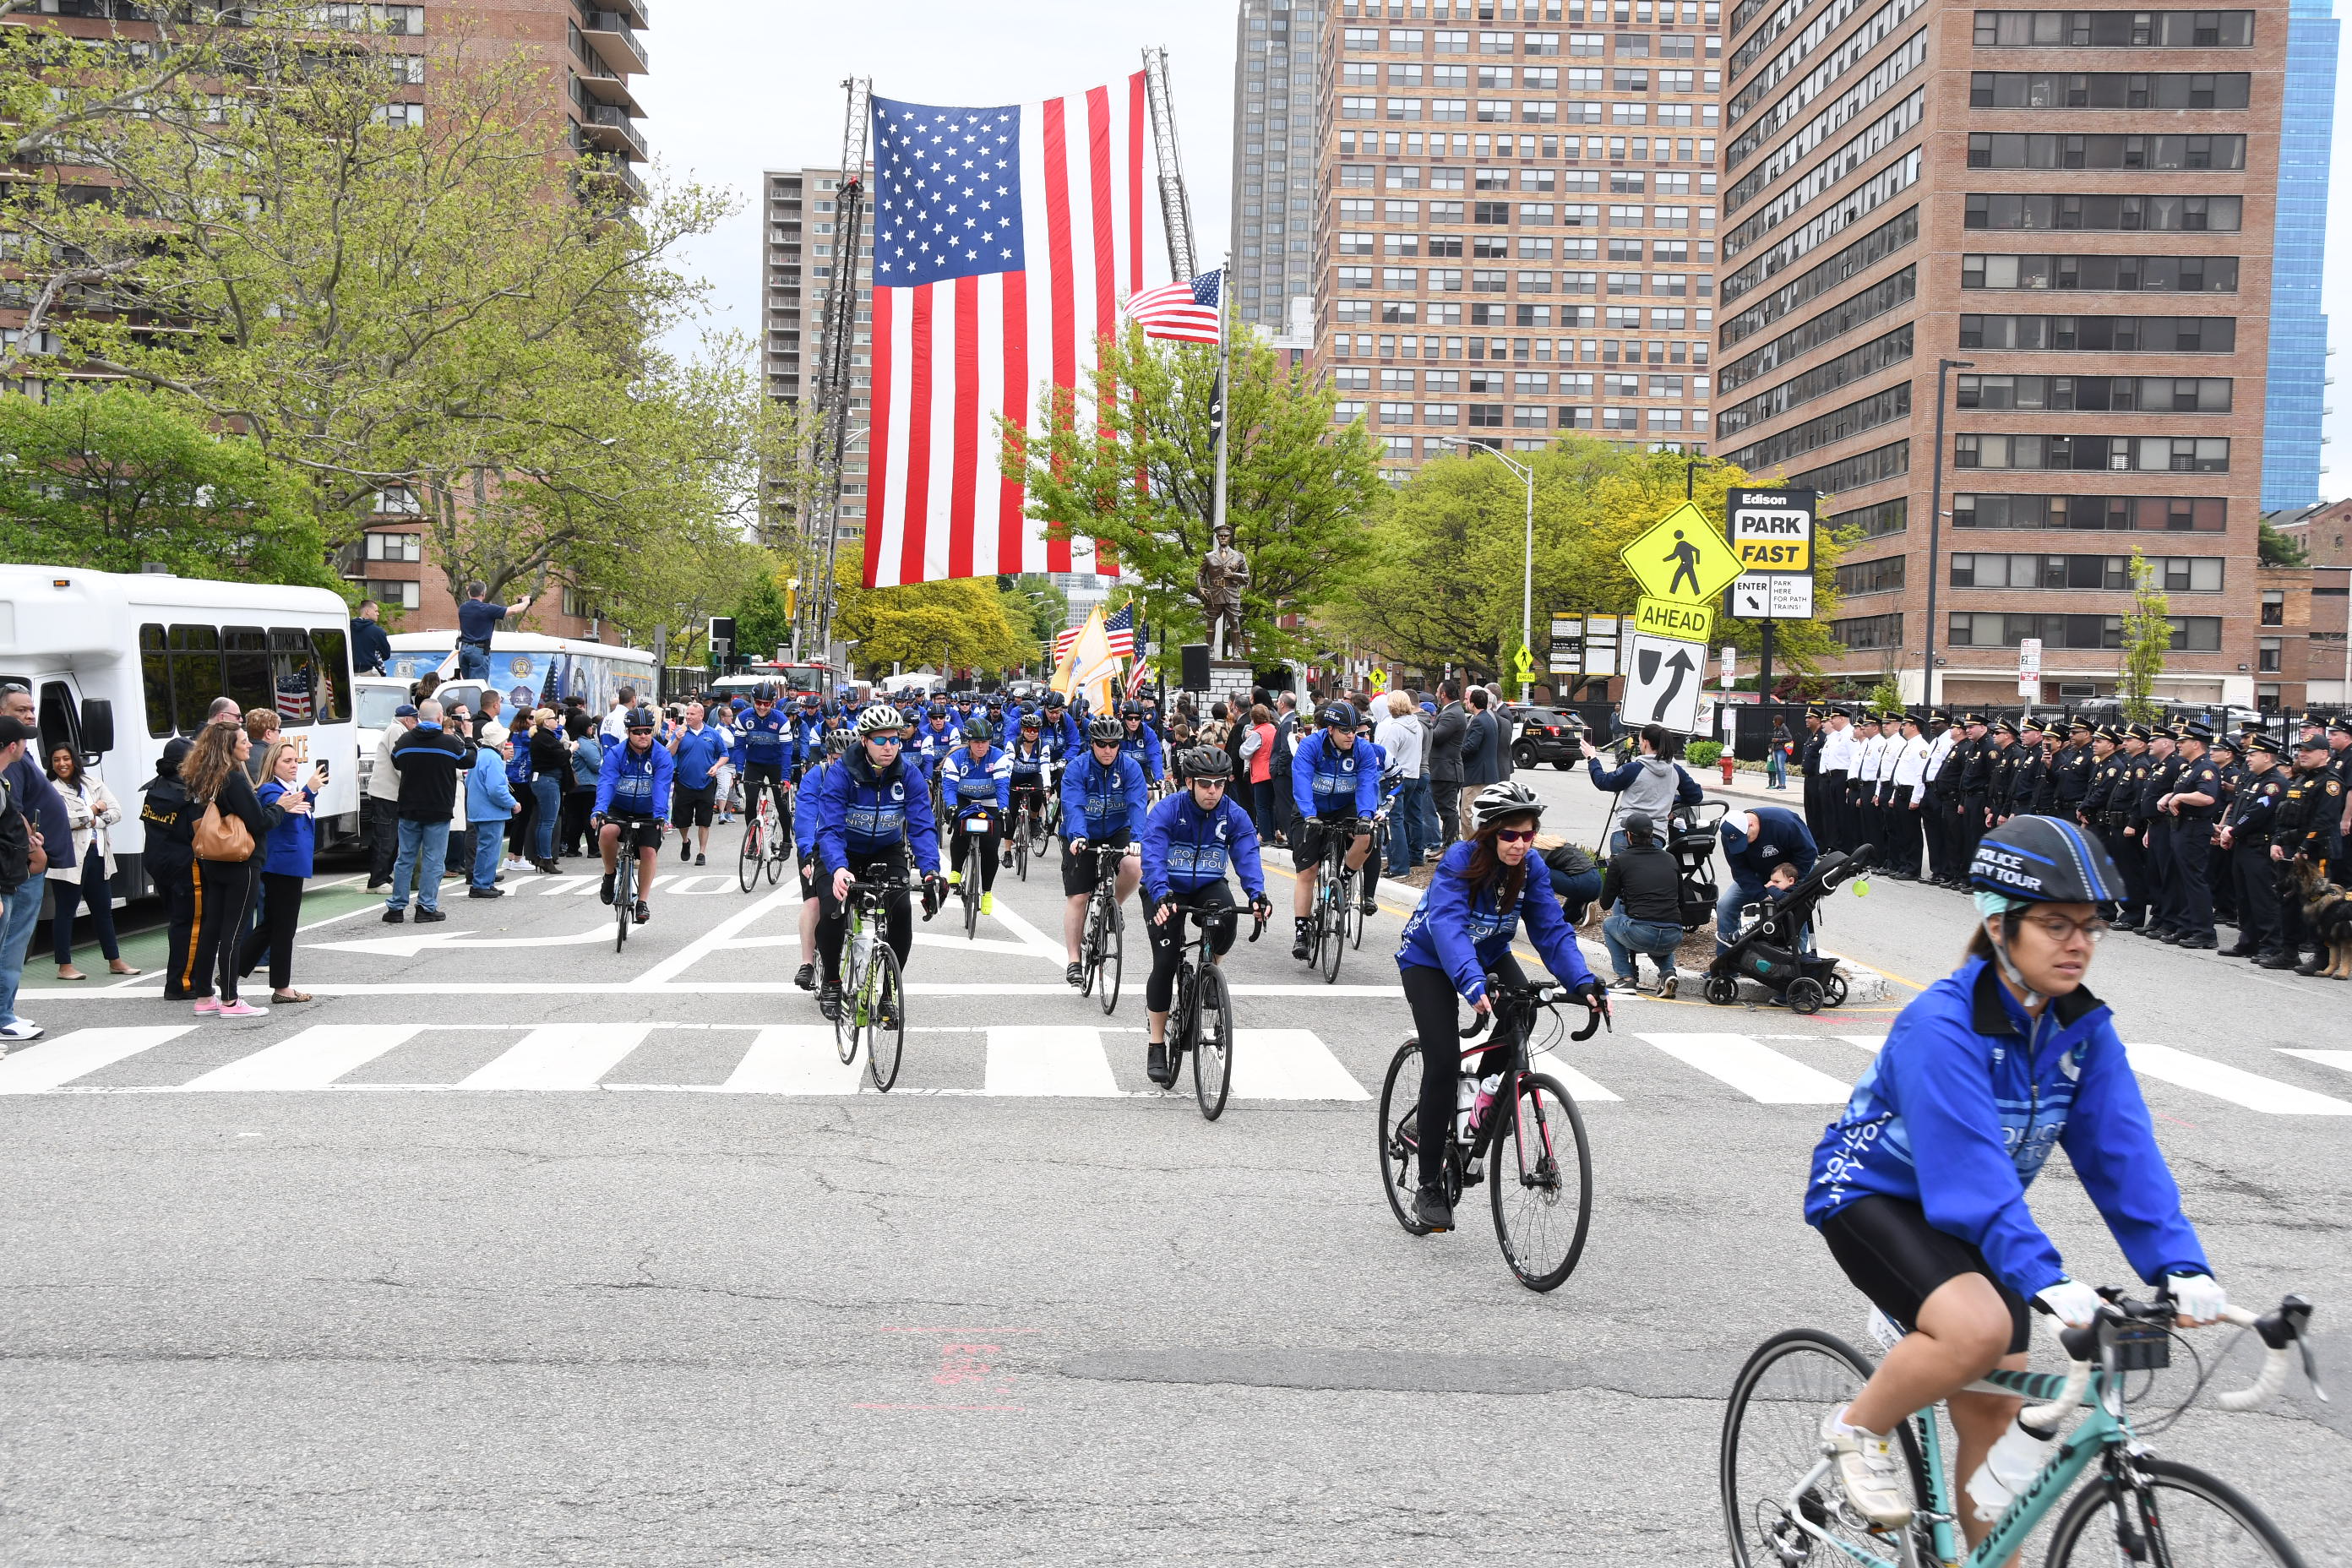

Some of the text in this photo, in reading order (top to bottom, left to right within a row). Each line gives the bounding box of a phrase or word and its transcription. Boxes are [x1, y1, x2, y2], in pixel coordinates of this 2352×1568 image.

[1742, 494, 1787, 505] Edison
[1741, 516, 1801, 534] PARK
[1741, 546, 1799, 563] FAST
[1737, 583, 1767, 591] ENTER
[1642, 606, 1706, 631] AHEAD
[845, 817, 902, 828] NITY TOU
[852, 812, 899, 823] POLICE
[1173, 849, 1219, 860] POLICE
[1975, 847, 2023, 869] POLICE
[1167, 857, 1226, 870] NITY TOU
[1995, 867, 2042, 891] TOUR
[2000, 1121, 2067, 1146] OLICE
[1817, 1122, 1863, 1184] POLIC
